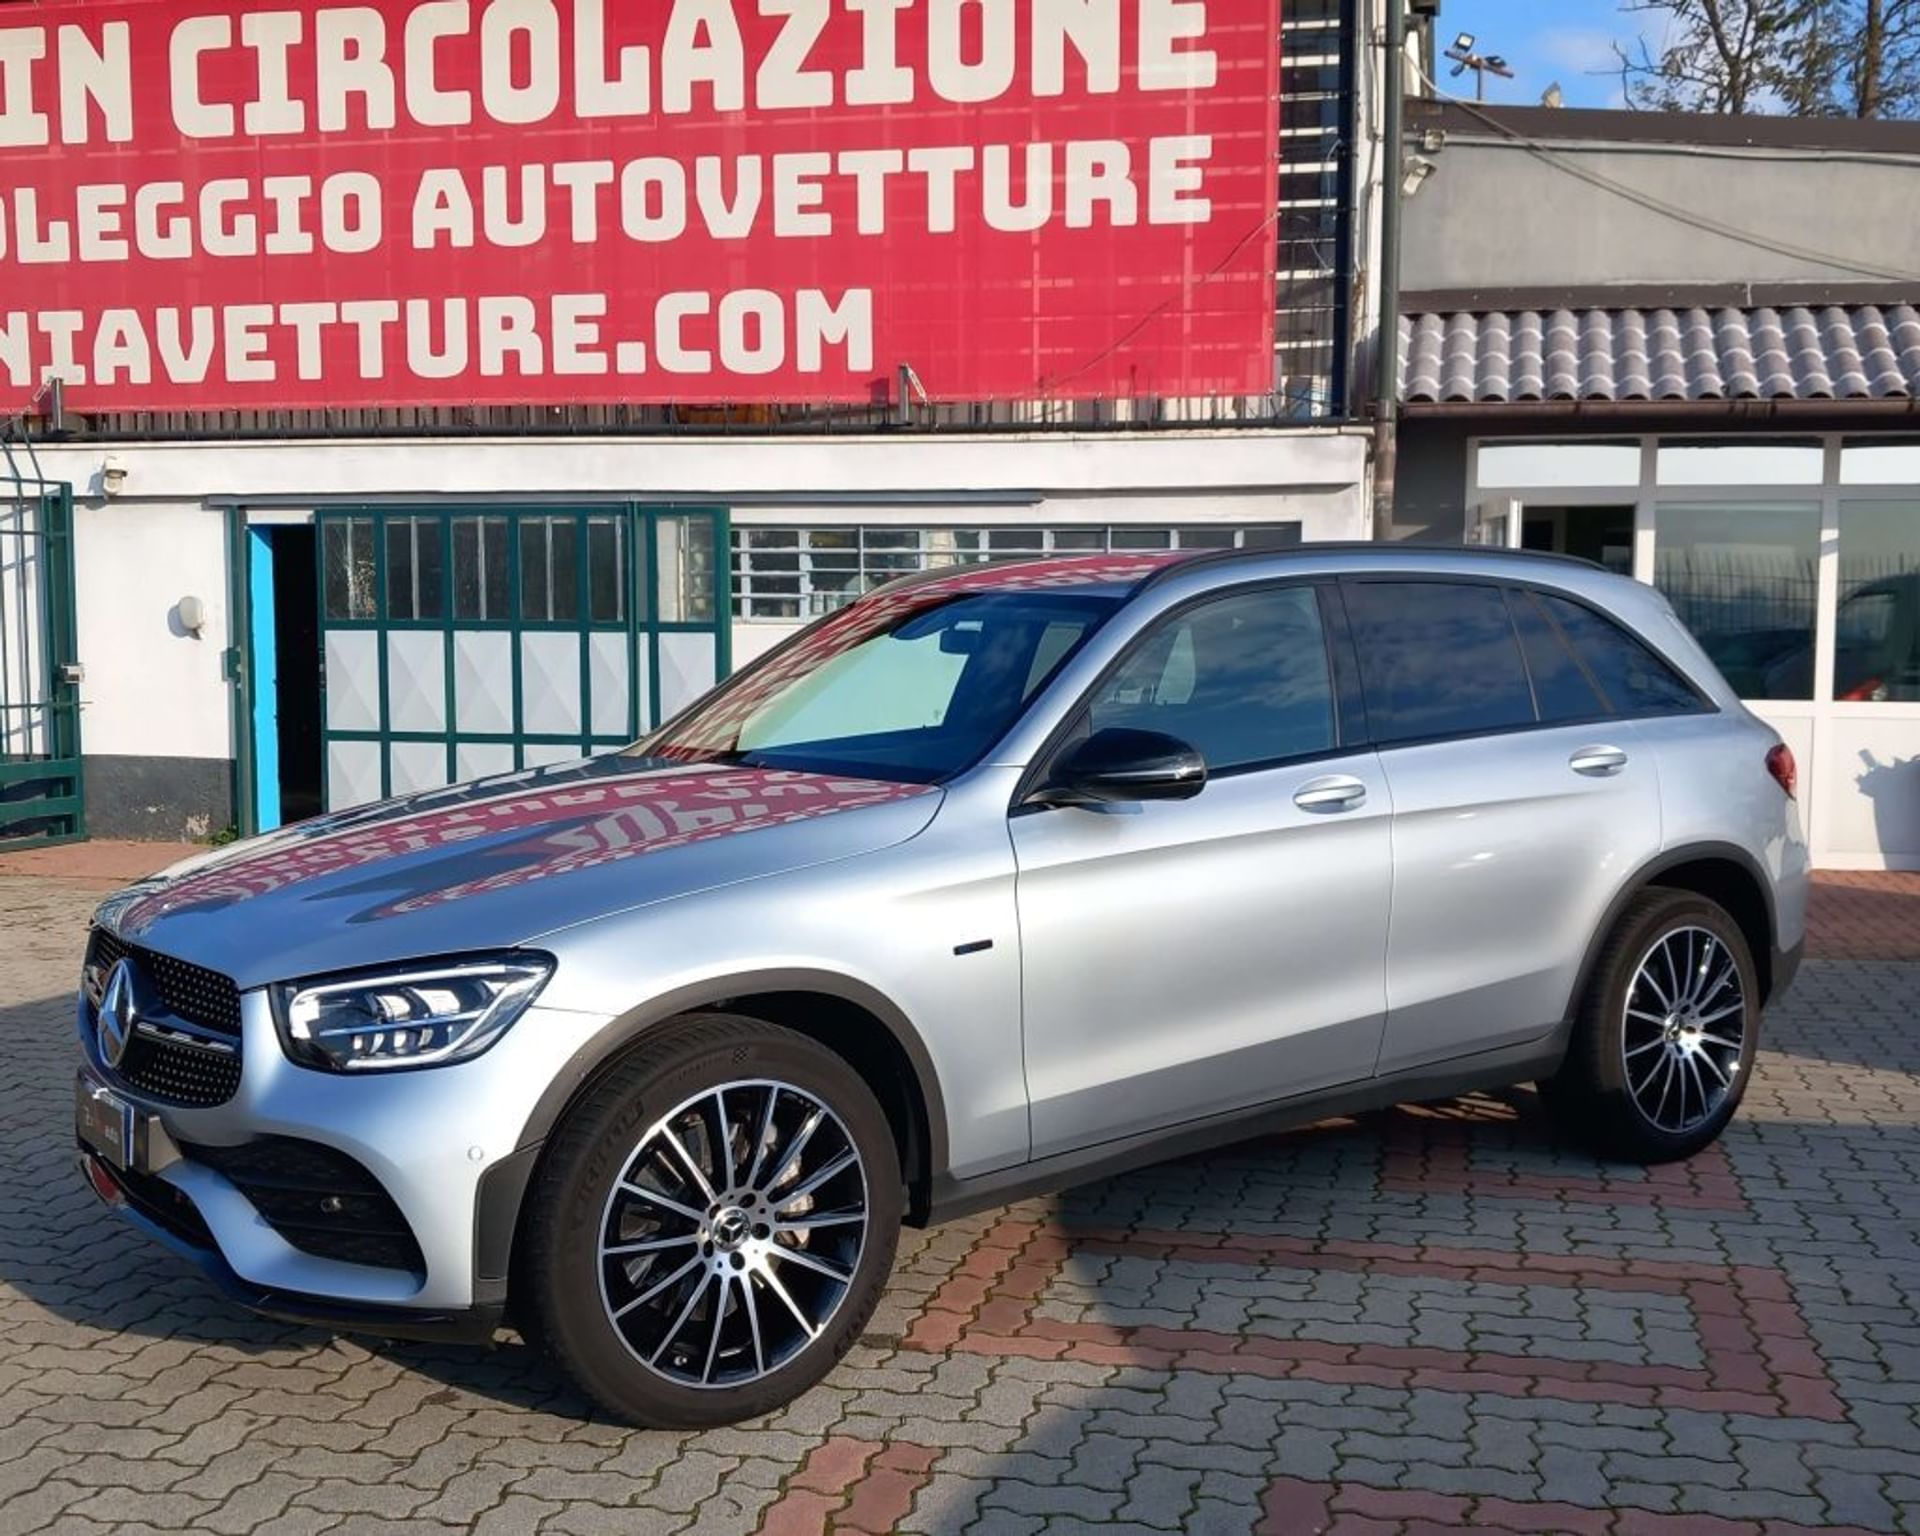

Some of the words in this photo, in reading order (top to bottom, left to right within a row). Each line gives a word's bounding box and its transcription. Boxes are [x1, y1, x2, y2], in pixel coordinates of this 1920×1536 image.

[0, 21, 133, 148] IN
[169, 0, 1218, 139] CIRCOLAZIONE
[0, 171, 382, 264] LEGGIO
[412, 134, 1213, 249] AUTOVETTURE
